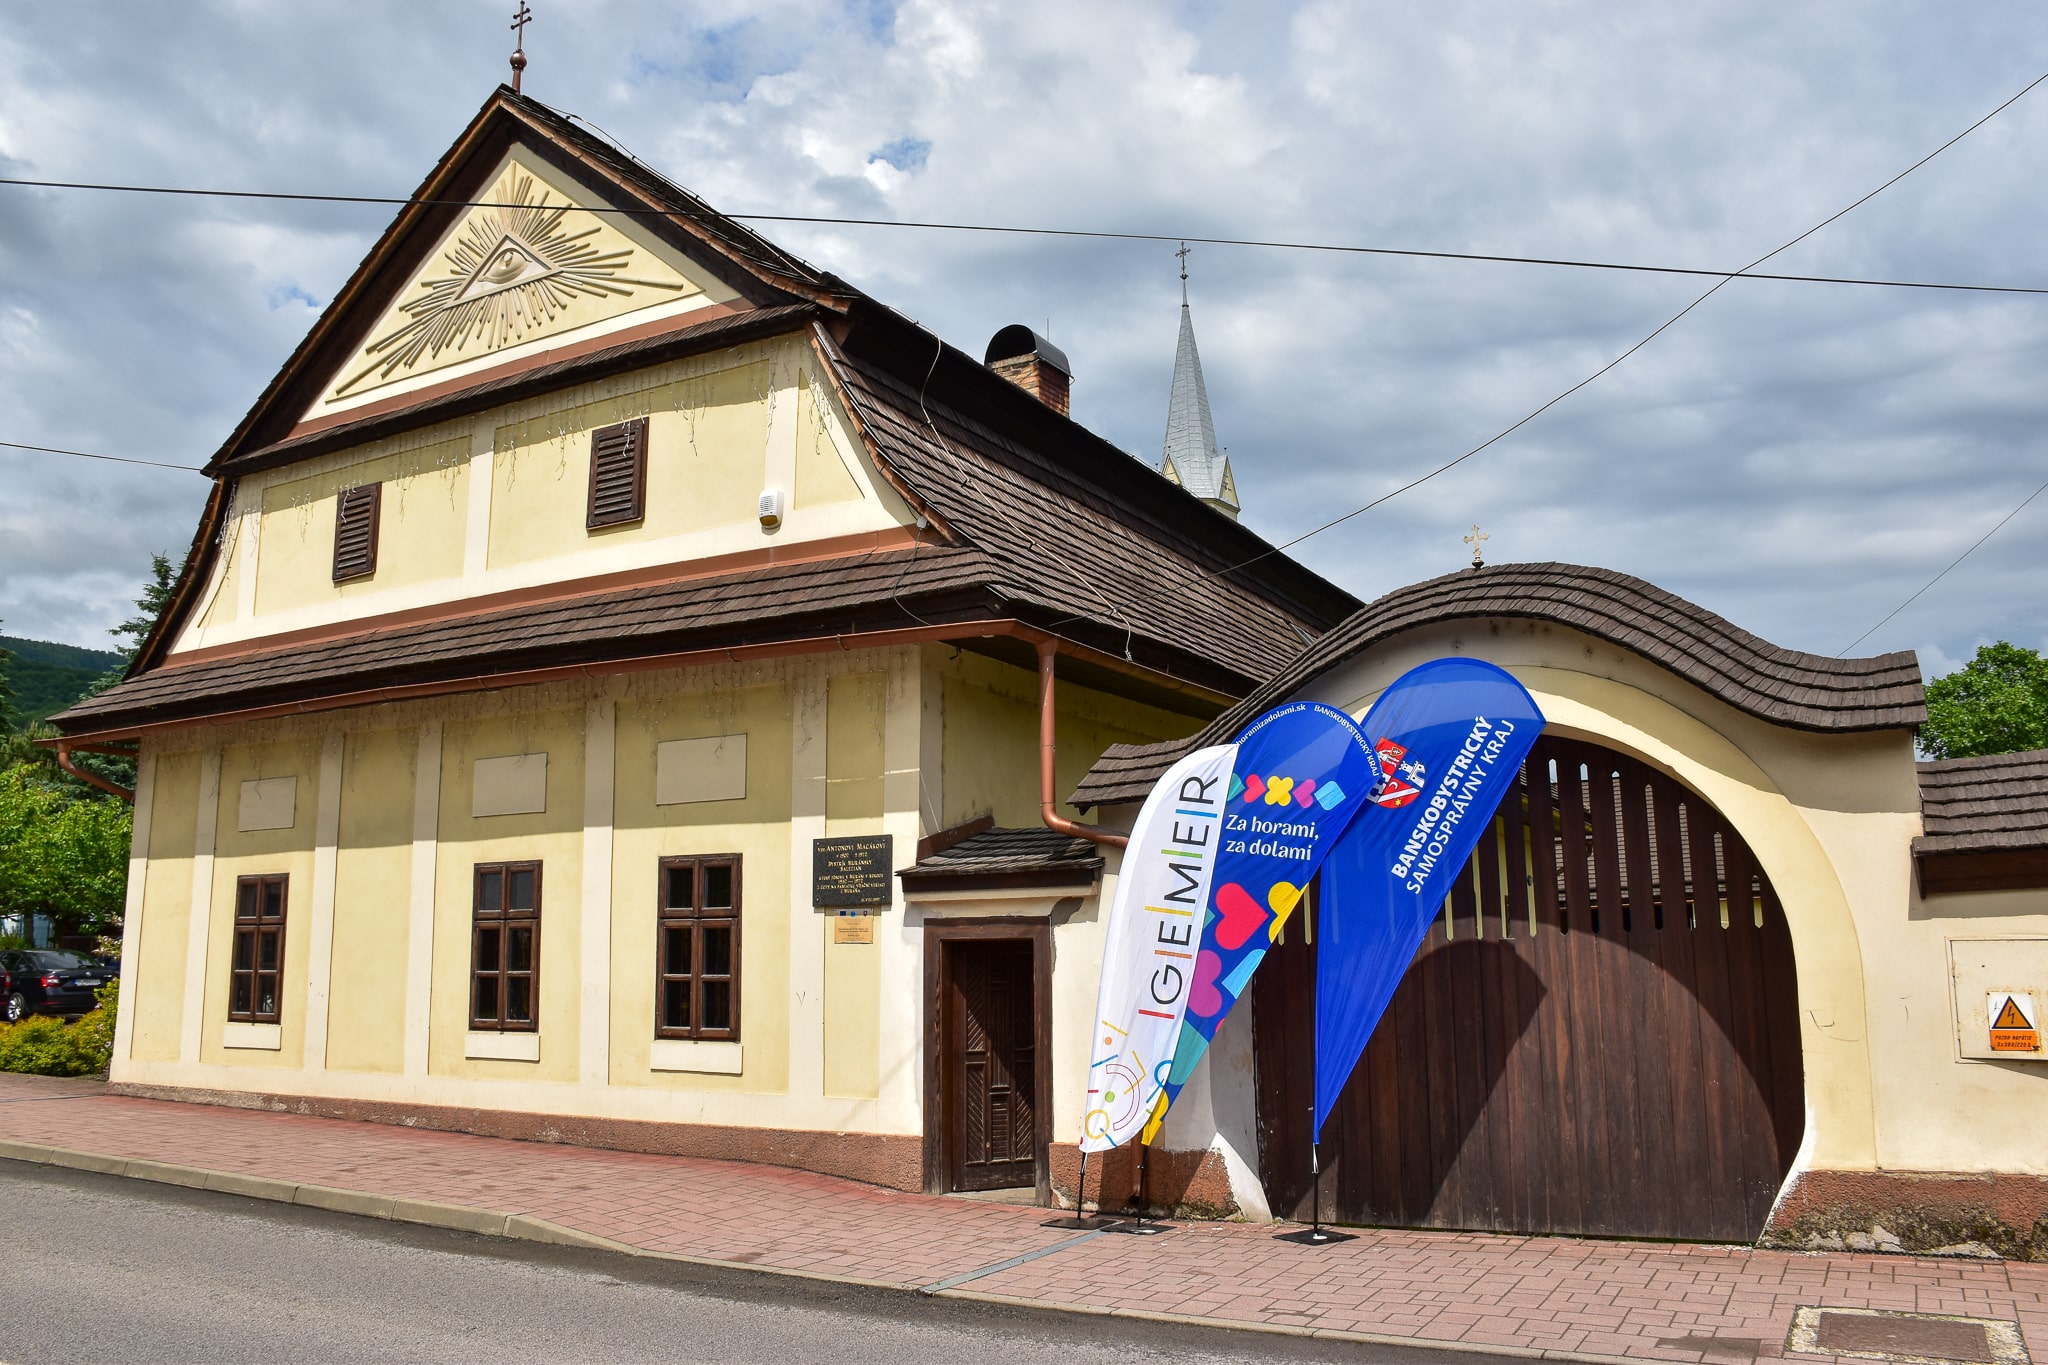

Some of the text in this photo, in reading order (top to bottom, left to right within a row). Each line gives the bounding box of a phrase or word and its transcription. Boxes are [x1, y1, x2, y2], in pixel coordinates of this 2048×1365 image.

[1314, 705, 1380, 777] BANSKOBYSTRICKÝ KRAJ
[1225, 814, 1319, 841] Za horami,
[1391, 715, 1493, 879] BANSKOBYSTRICKÝ
[1406, 719, 1515, 895] SAMOSPRÁVNY KRAJ
[1225, 838, 1312, 861] za dolami
